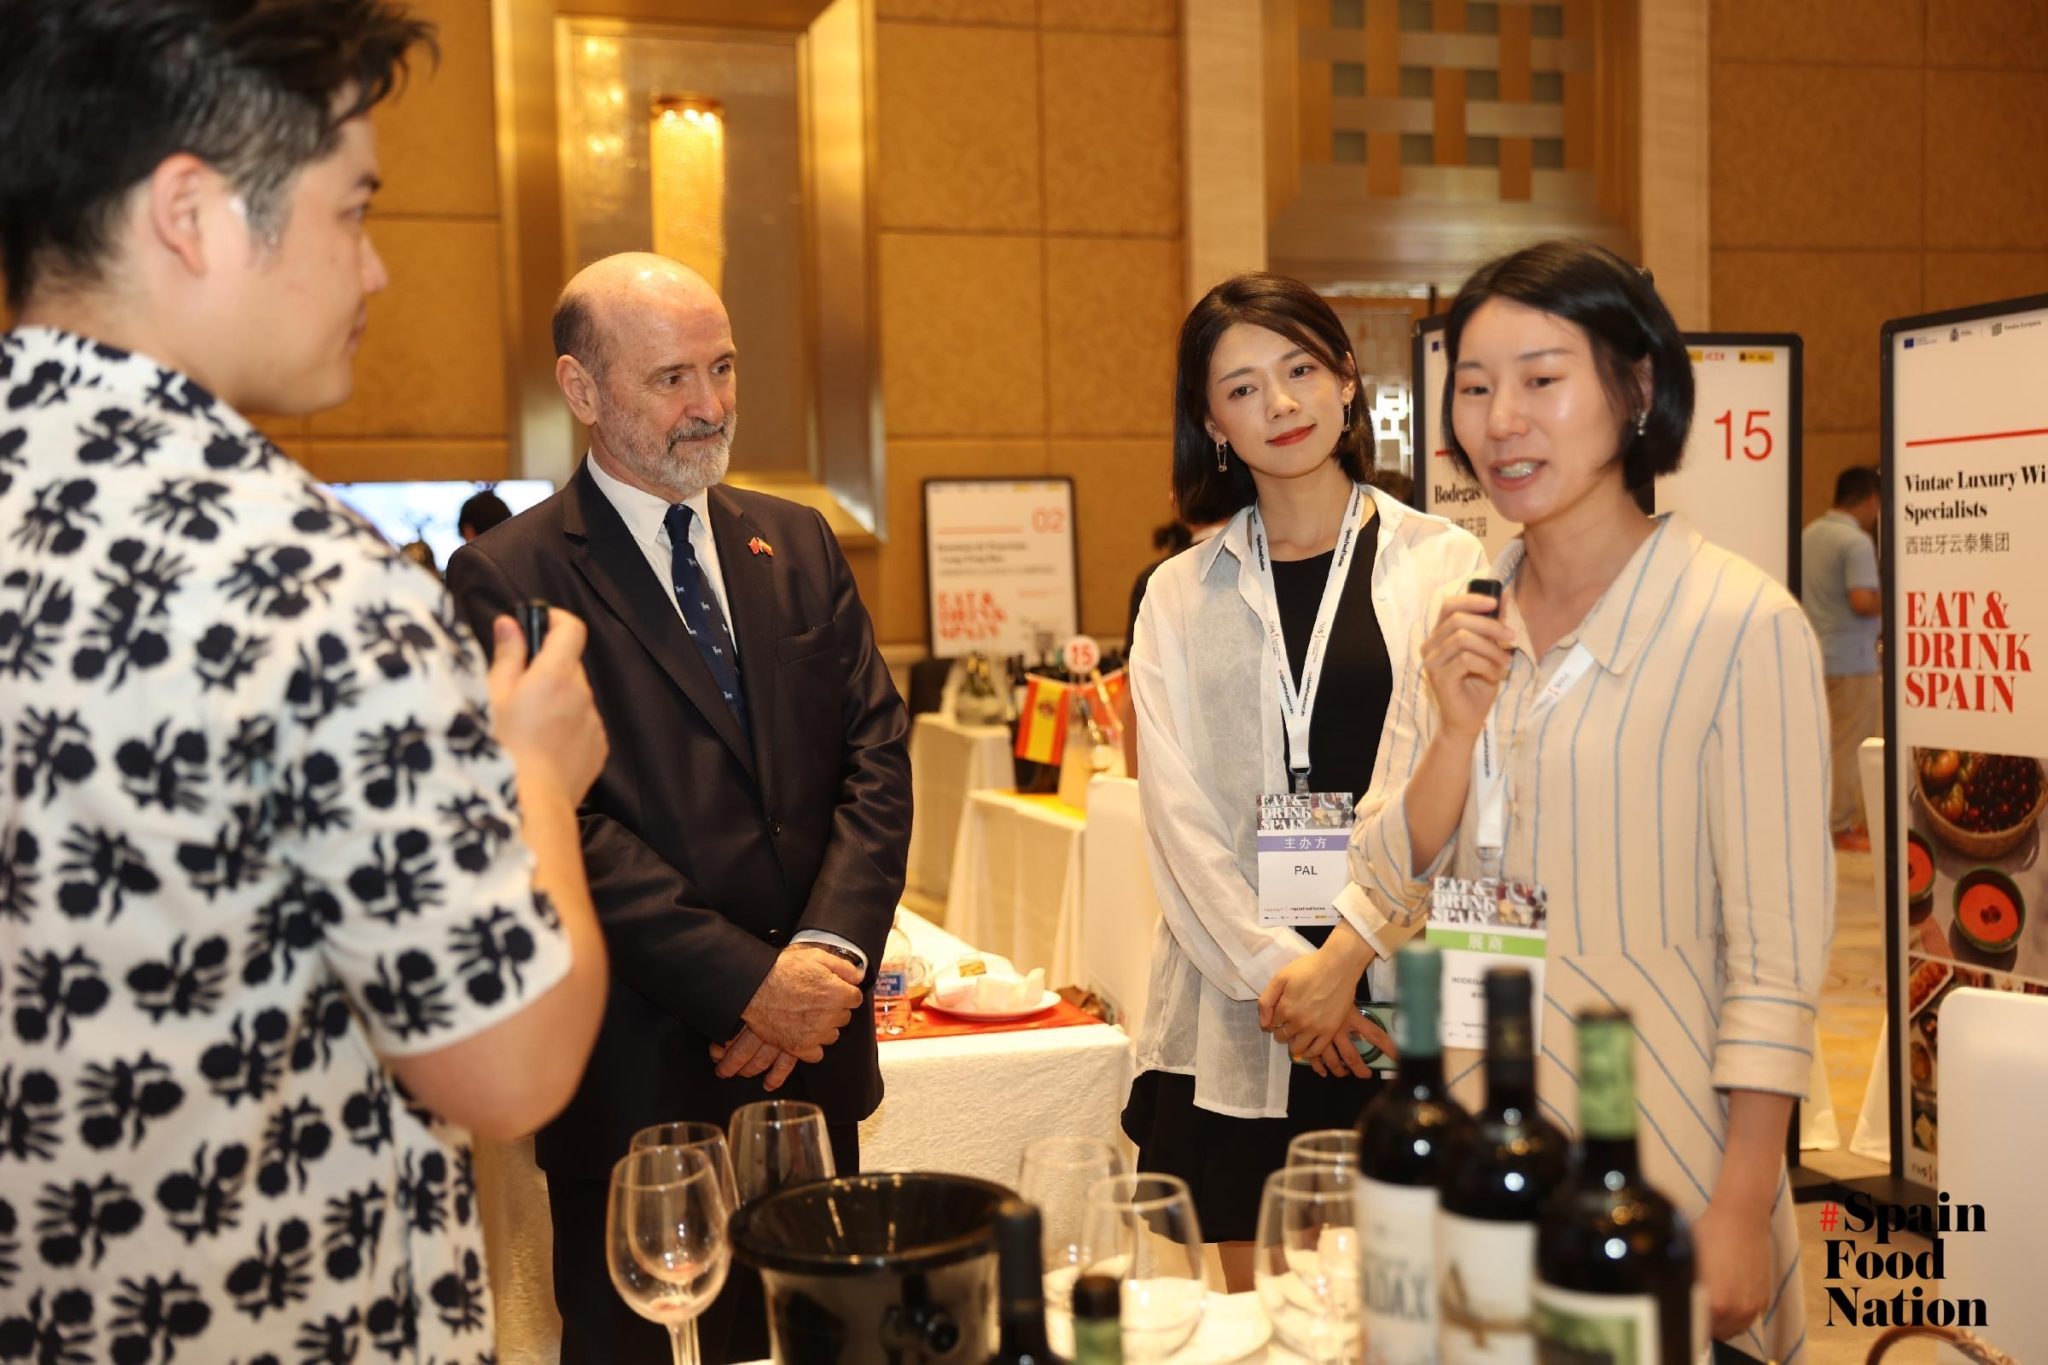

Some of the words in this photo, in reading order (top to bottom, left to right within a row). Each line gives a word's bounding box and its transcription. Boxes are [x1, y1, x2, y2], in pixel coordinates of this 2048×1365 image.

[1714, 410, 1773, 461] 15
[1958, 469, 2017, 492] Luxury
[1434, 485, 1480, 505] Bodegas
[1032, 505, 1065, 534] 02
[1905, 500, 1988, 525] Specialists
[1905, 532, 2010, 556] 西班牙云泰集团
[1906, 591, 1975, 629] EAT
[1982, 590, 2010, 630] &
[1071, 642, 1092, 665] 15
[1907, 631, 2032, 672] DRINK
[1905, 671, 2016, 714] SPAIN
[1284, 837, 1328, 850] 主办方
[1294, 865, 1318, 876] PAL
